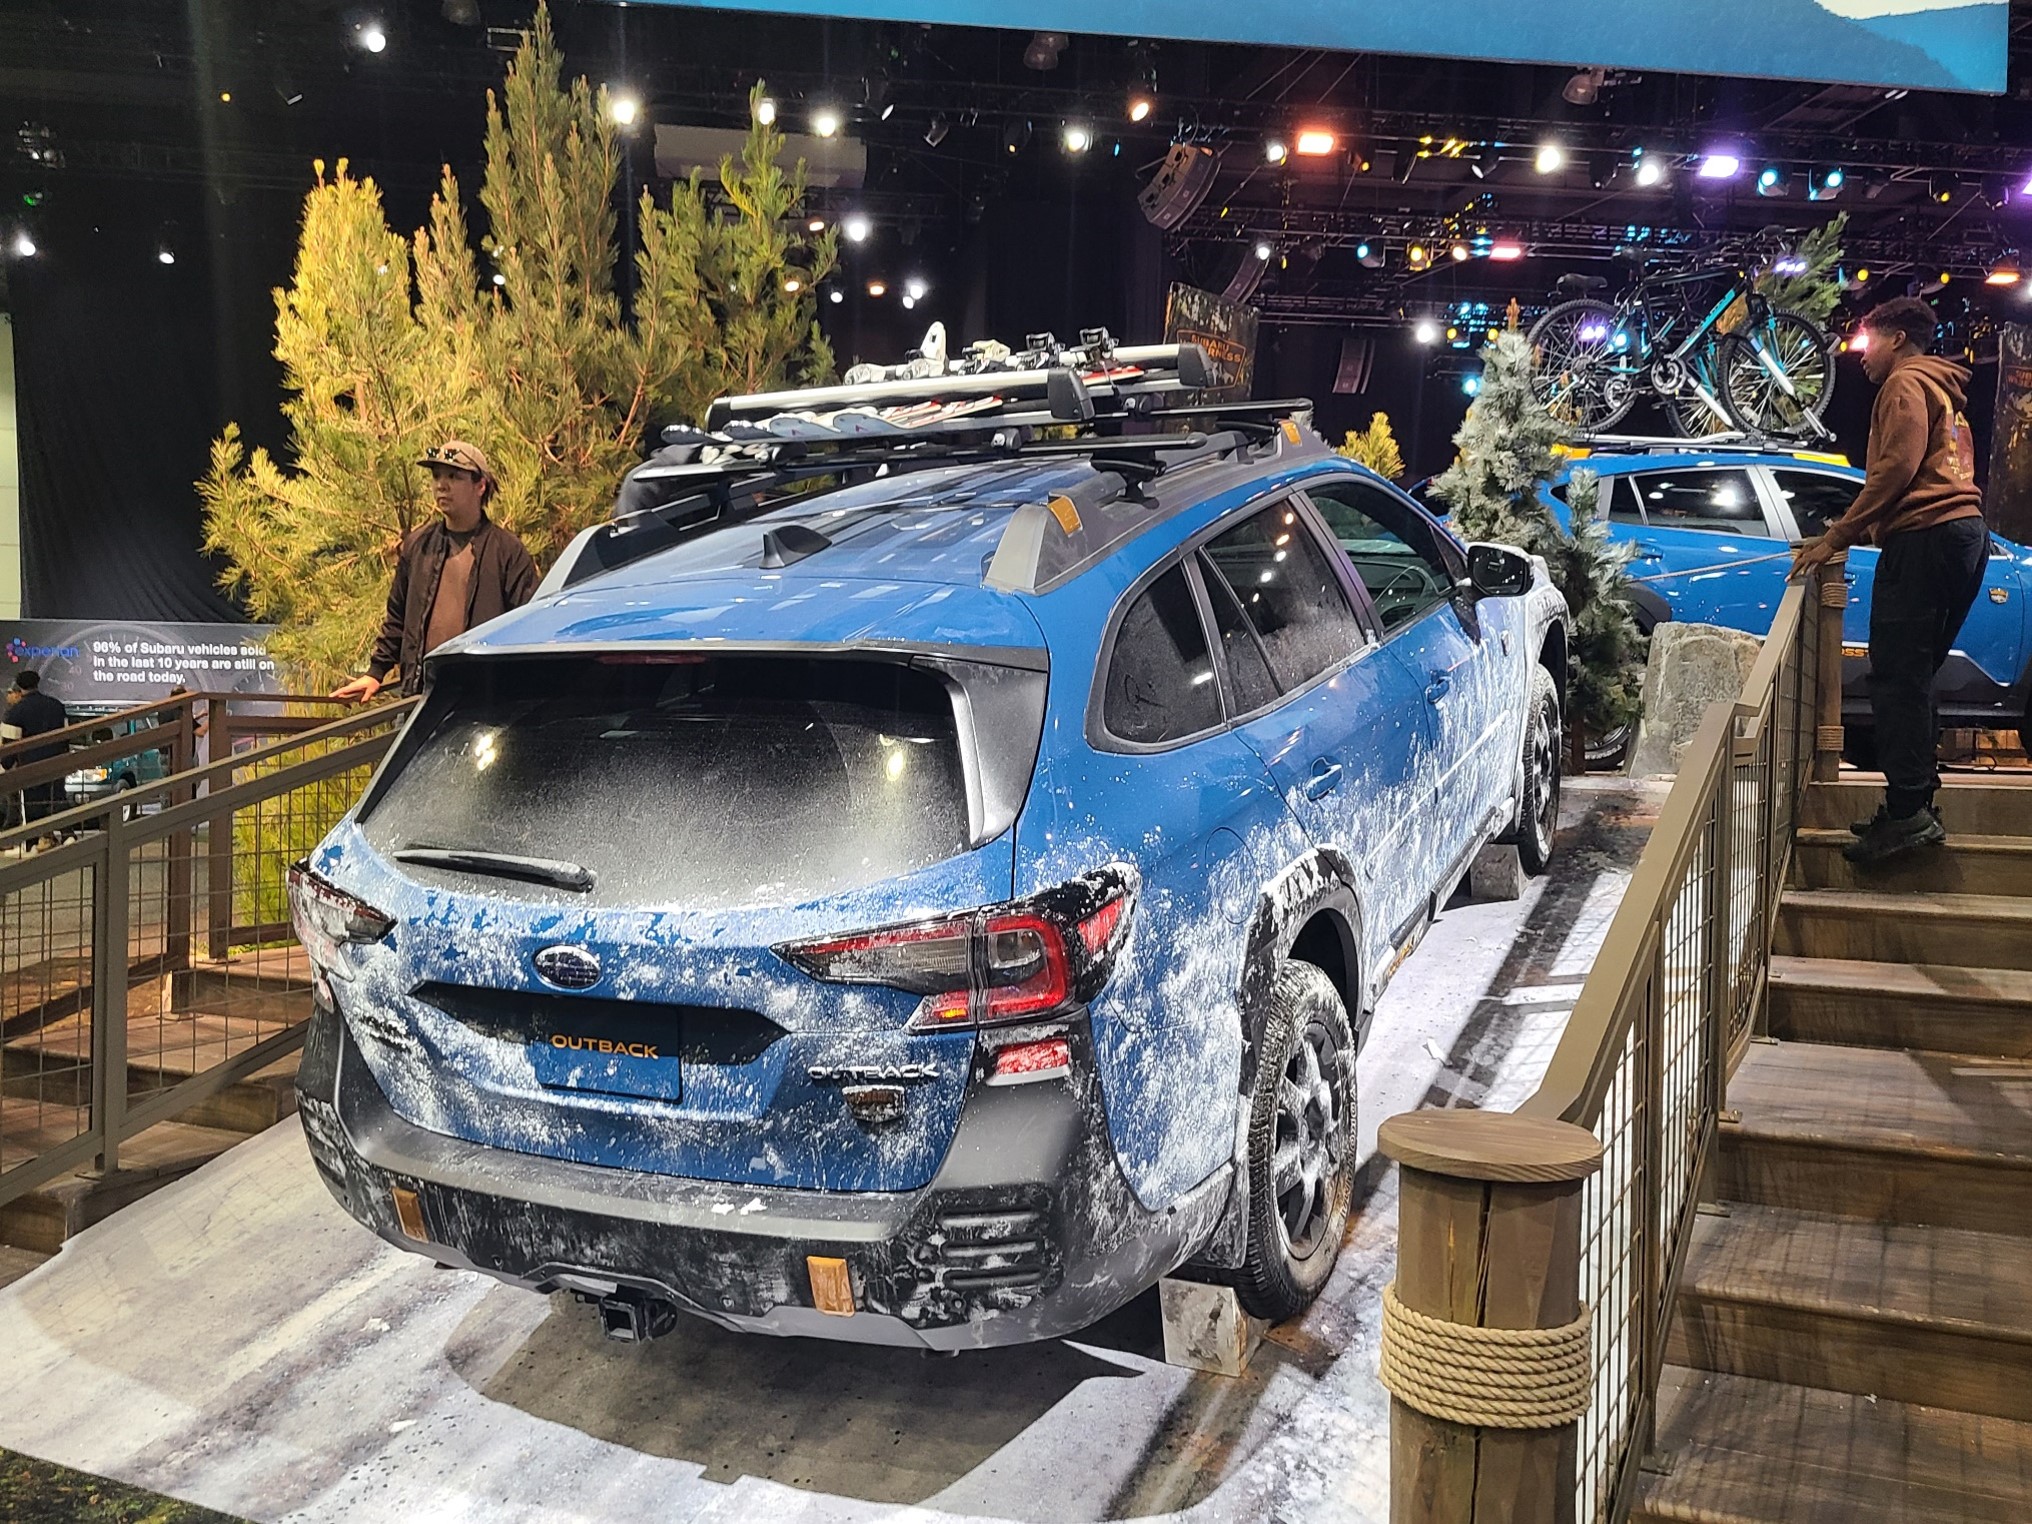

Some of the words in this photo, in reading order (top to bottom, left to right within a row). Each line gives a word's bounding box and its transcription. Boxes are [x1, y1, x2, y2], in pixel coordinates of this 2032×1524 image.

[14, 646, 80, 659] experian
[124, 642, 138, 654] of
[140, 642, 185, 655] Subaru
[187, 643, 238, 656] vehicles
[108, 655, 129, 668] the
[131, 656, 155, 668] last
[157, 657, 173, 669] 10
[174, 659, 209, 671] years
[211, 659, 232, 670] are
[234, 658, 256, 670] still
[258, 660, 275, 670] on
[93, 669, 114, 682] the
[117, 671, 146, 683] road
[148, 671, 186, 686] today.
[550, 1034, 659, 1060] OUTBACK
